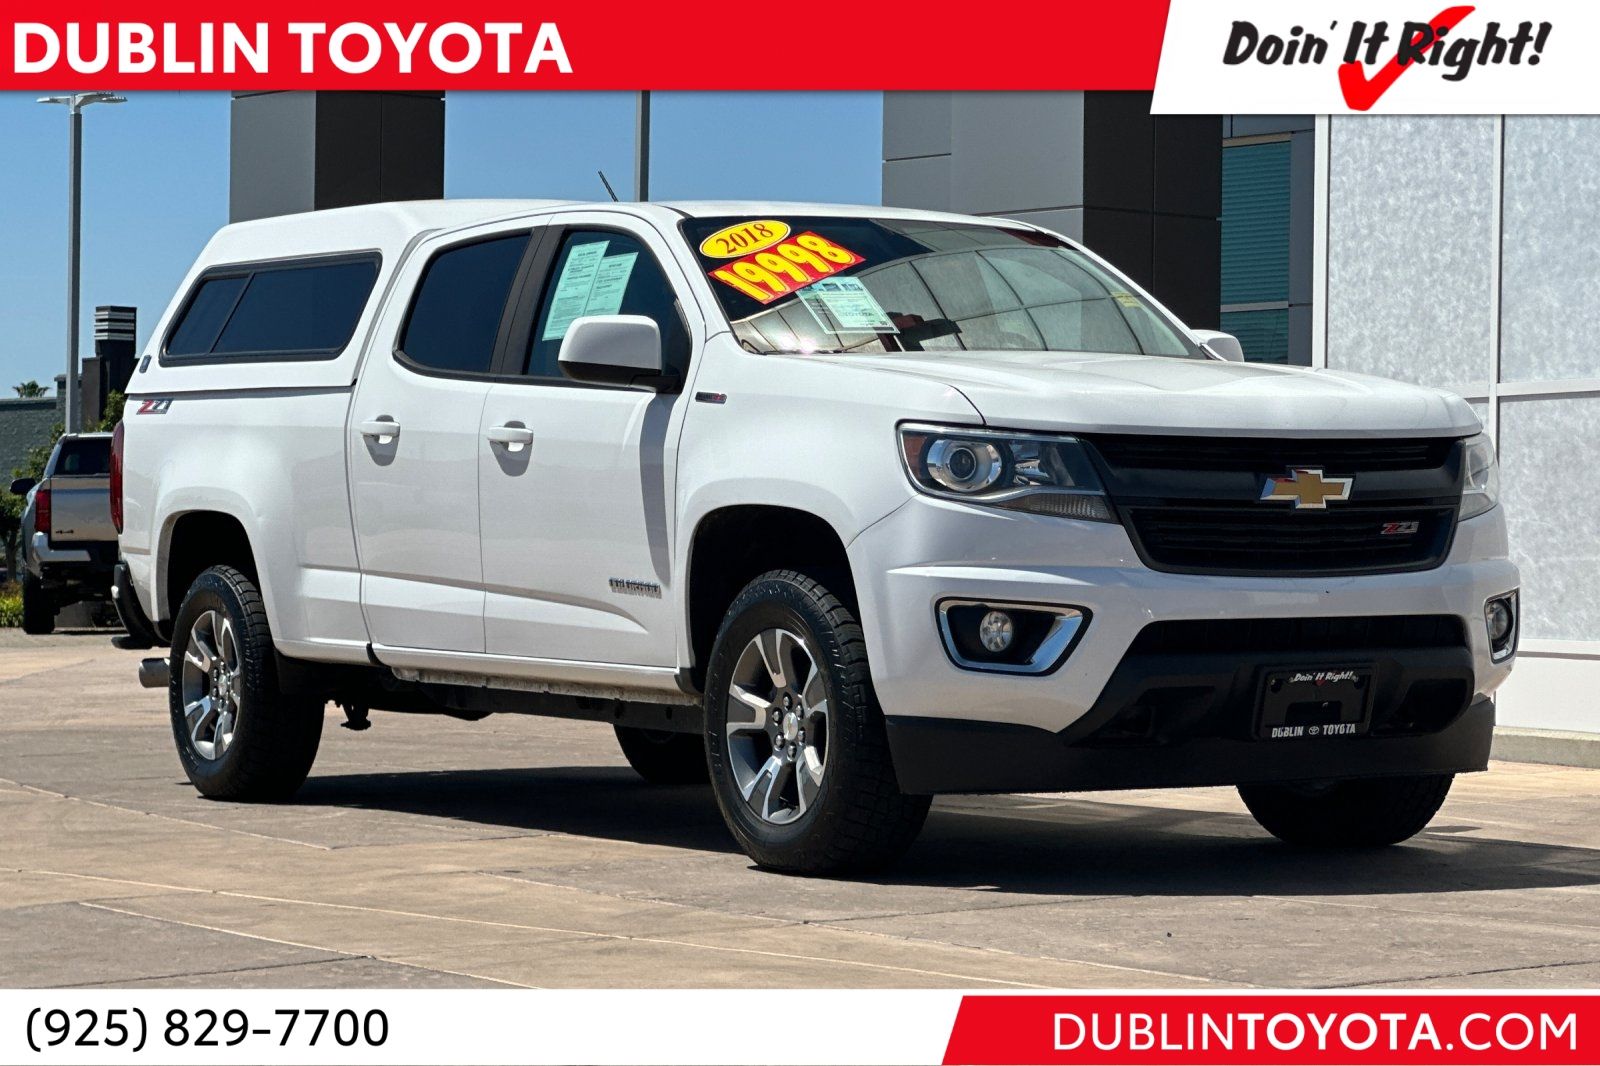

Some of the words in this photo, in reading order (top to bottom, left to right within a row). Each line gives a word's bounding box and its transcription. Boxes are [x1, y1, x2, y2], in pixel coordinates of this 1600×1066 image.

[715, 222, 775, 254] 2018
[713, 233, 855, 301] 19998
[1315, 672, 1325, 681] It
[1325, 670, 1354, 683] Right!
[1271, 725, 1305, 739] DUBLIN
[1322, 723, 1357, 736] TOYOTA
